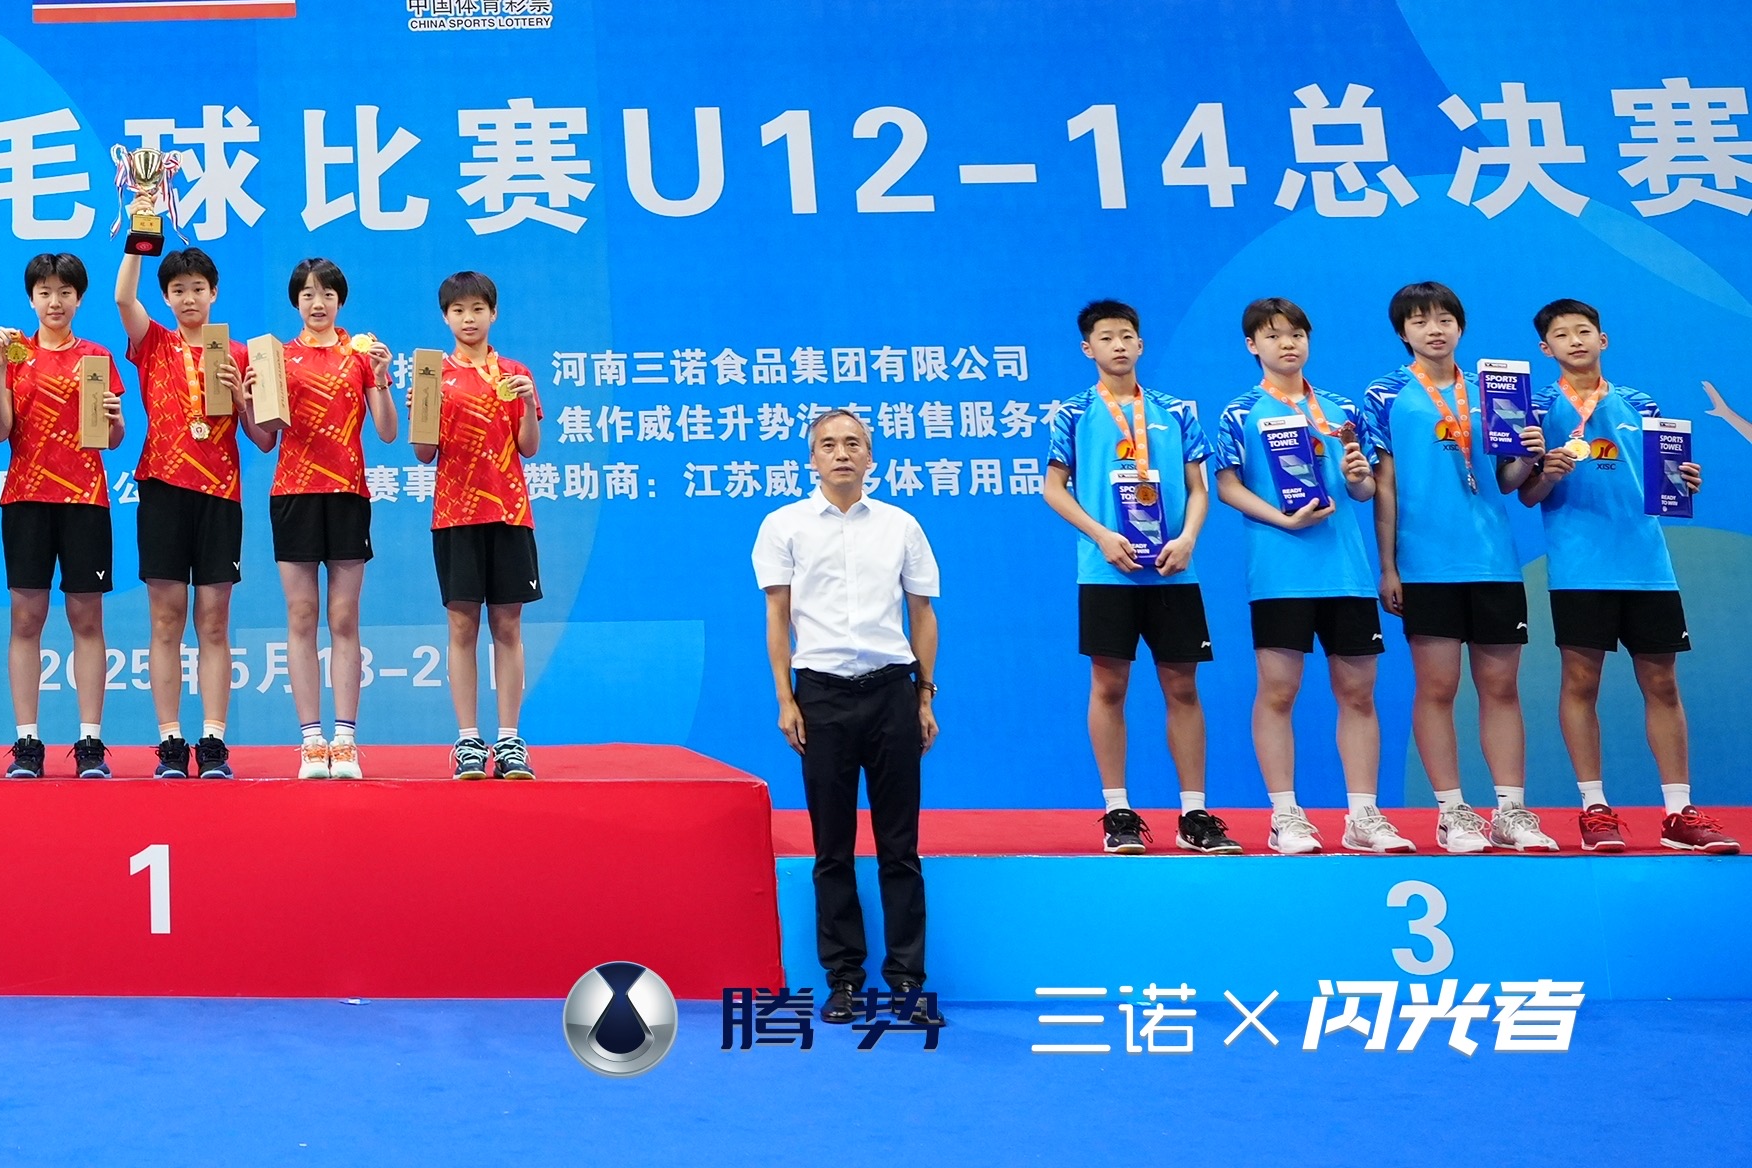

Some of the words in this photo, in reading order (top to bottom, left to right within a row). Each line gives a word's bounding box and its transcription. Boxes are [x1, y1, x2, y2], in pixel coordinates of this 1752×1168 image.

[409, 18, 447, 29] CHINA
[449, 18, 495, 29] SPORTS
[497, 17, 551, 29] LOTTERY
[551, 345, 1029, 387] 河南三诺食品集团有限公司
[1484, 375, 1518, 383] SPORTS
[1486, 382, 1517, 391] TOWEL
[1266, 431, 1298, 441] SPORTS
[1659, 435, 1684, 444] SPORTS
[1268, 439, 1299, 448] TOWEL
[1660, 443, 1683, 452] TOWEL
[129, 843, 172, 934] 1
[1385, 880, 1455, 976] 3
